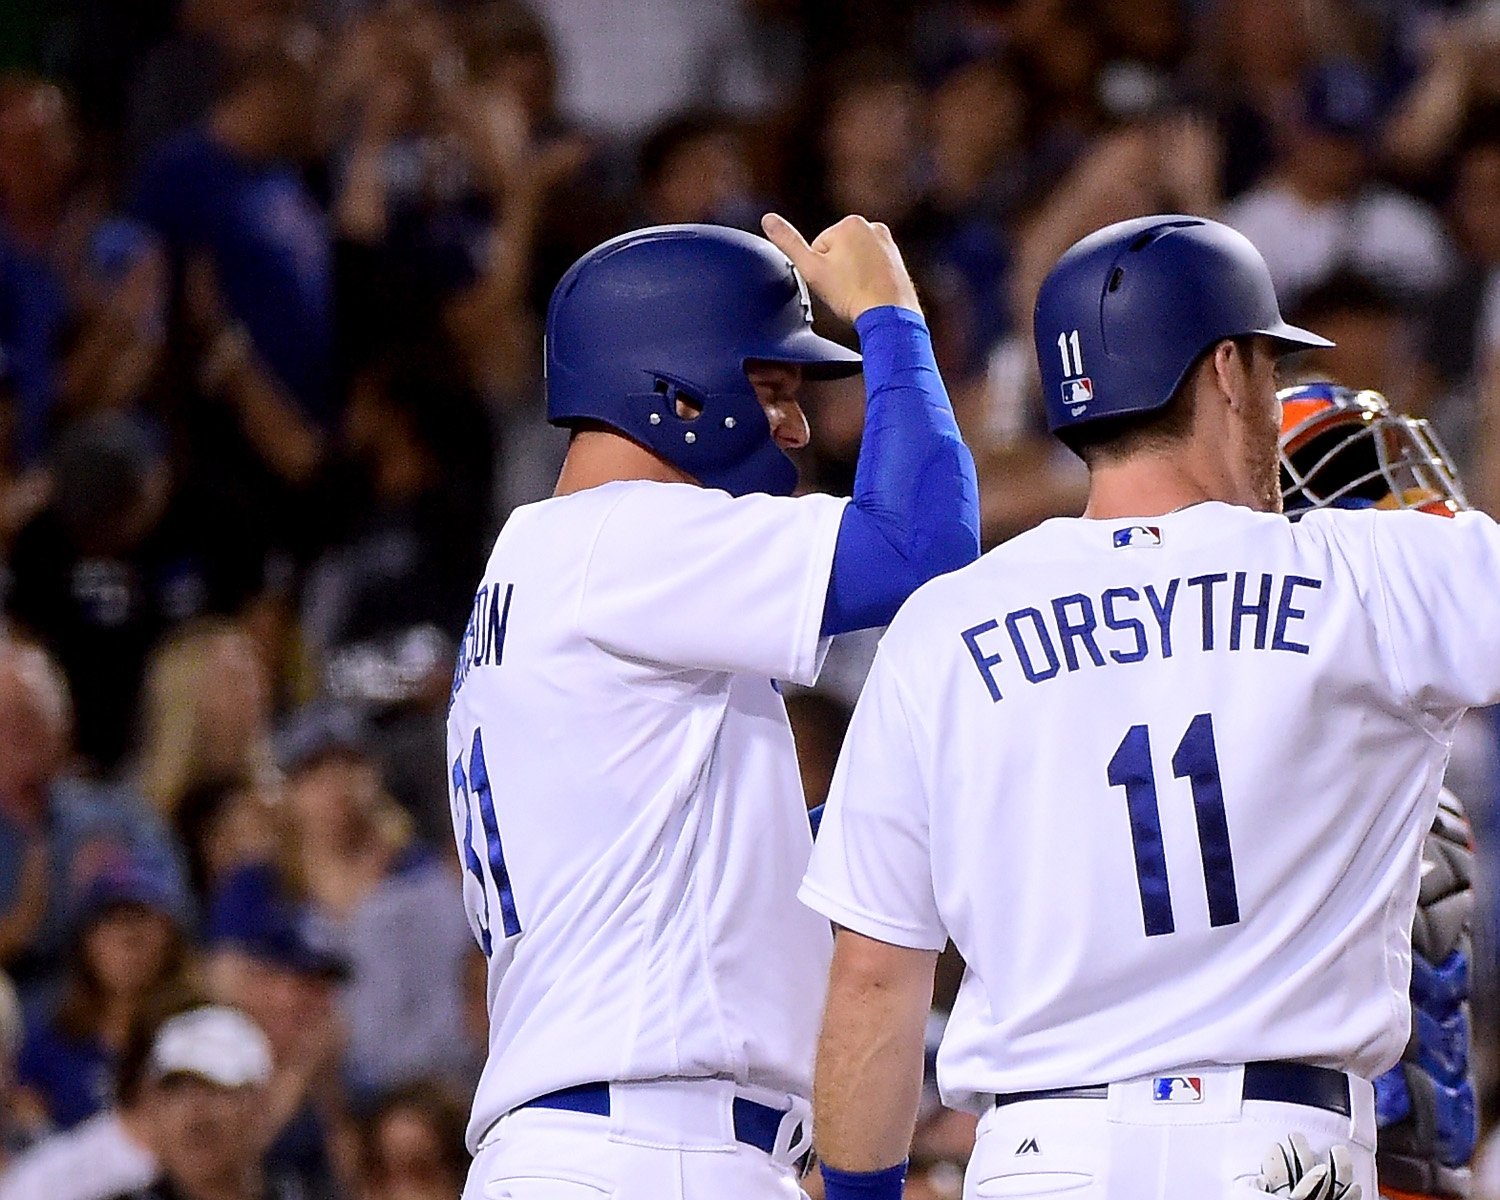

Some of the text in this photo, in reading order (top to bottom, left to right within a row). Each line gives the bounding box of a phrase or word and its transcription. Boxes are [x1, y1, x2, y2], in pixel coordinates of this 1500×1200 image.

[1058, 330, 1083, 377] 11
[960, 571, 1322, 703] FORSYTHE
[1106, 712, 1240, 937] 11
